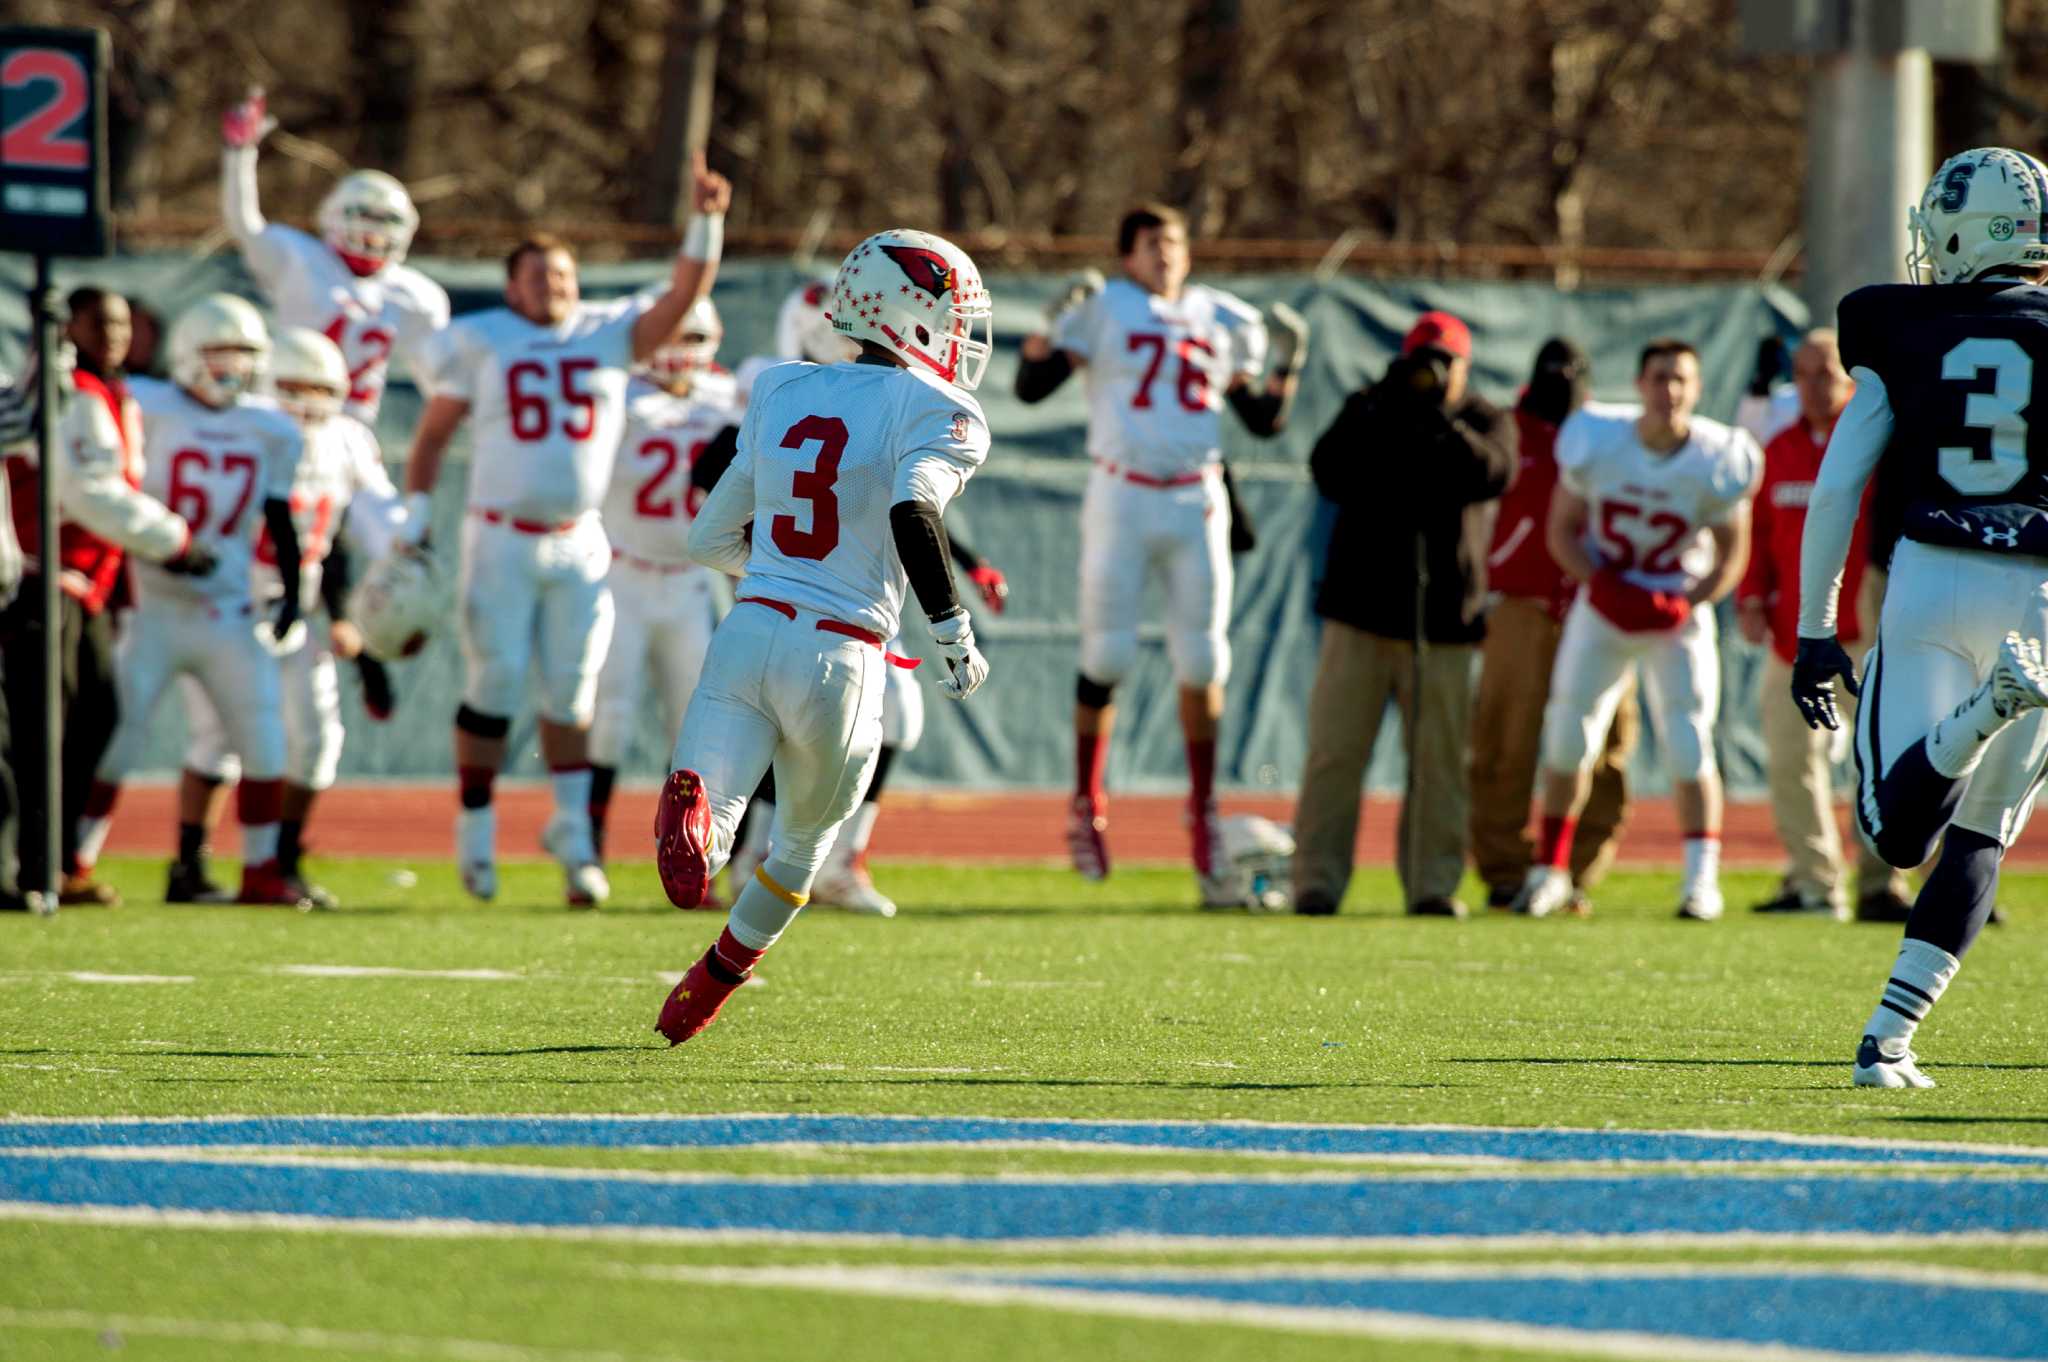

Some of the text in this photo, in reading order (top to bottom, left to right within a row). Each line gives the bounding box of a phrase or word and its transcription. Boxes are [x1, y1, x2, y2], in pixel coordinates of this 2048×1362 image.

[0, 49, 88, 168] 2
[1941, 162, 1976, 213] S
[1993, 222, 2010, 234] 26
[507, 357, 598, 442] 65
[1127, 333, 1217, 413] 76
[1938, 337, 2033, 495] 3
[167, 449, 257, 537] 67
[771, 415, 849, 561] 3
[1600, 501, 1688, 573] 52
